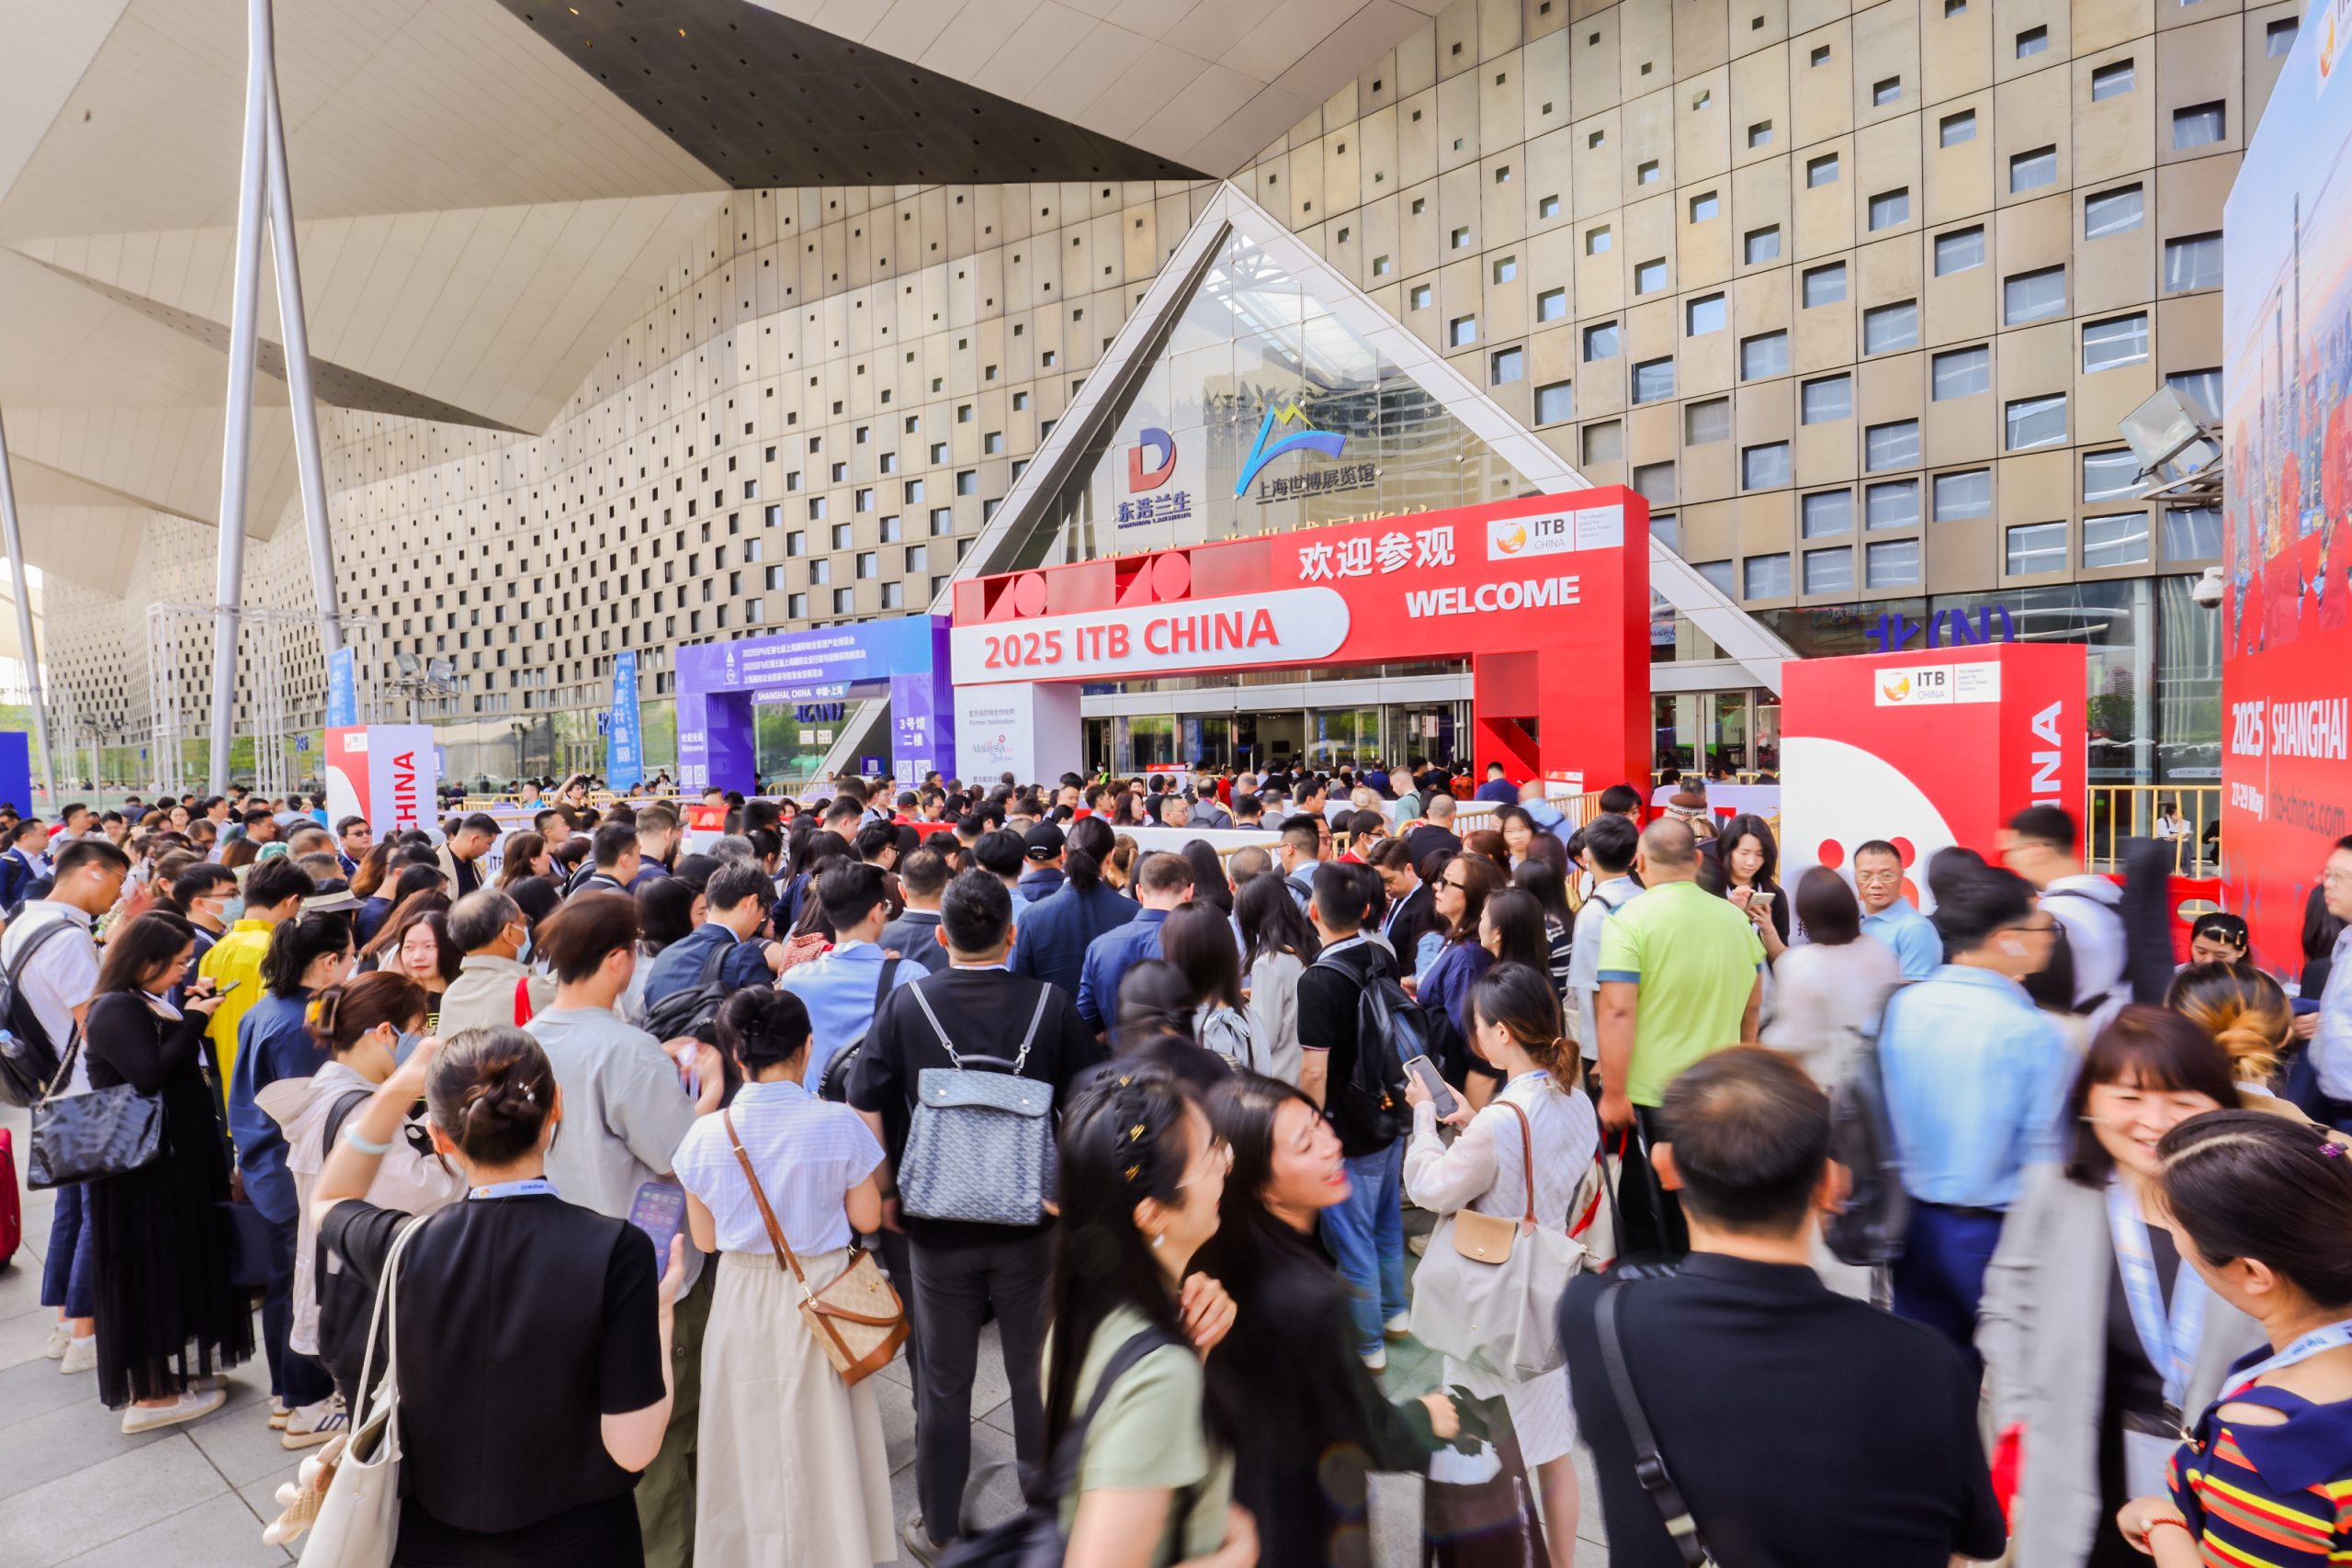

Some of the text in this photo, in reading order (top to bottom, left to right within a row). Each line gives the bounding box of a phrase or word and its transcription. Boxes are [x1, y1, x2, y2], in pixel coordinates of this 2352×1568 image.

[1256, 463, 1375, 500] 上海世博展览馆
[1118, 491, 1192, 522] 东浩兰生
[1534, 518, 1565, 536] ITB
[1298, 525, 1456, 581] 欢迎参观
[1534, 538, 1566, 550] CHINA
[1406, 575, 1581, 618] WELCOME
[984, 608, 1280, 669] 2025 ITB CHINA
[1917, 671, 1945, 686] ITB
[757, 690, 790, 701] SHANGHAI,
[791, 688, 812, 699] CHINA
[1917, 690, 1945, 700] CHINA
[899, 716, 926, 730] 3号馆
[2232, 698, 2348, 760] 2025 SHANGHAI
[903, 733, 923, 747] 二楼
[2248, 785, 2264, 821] May
